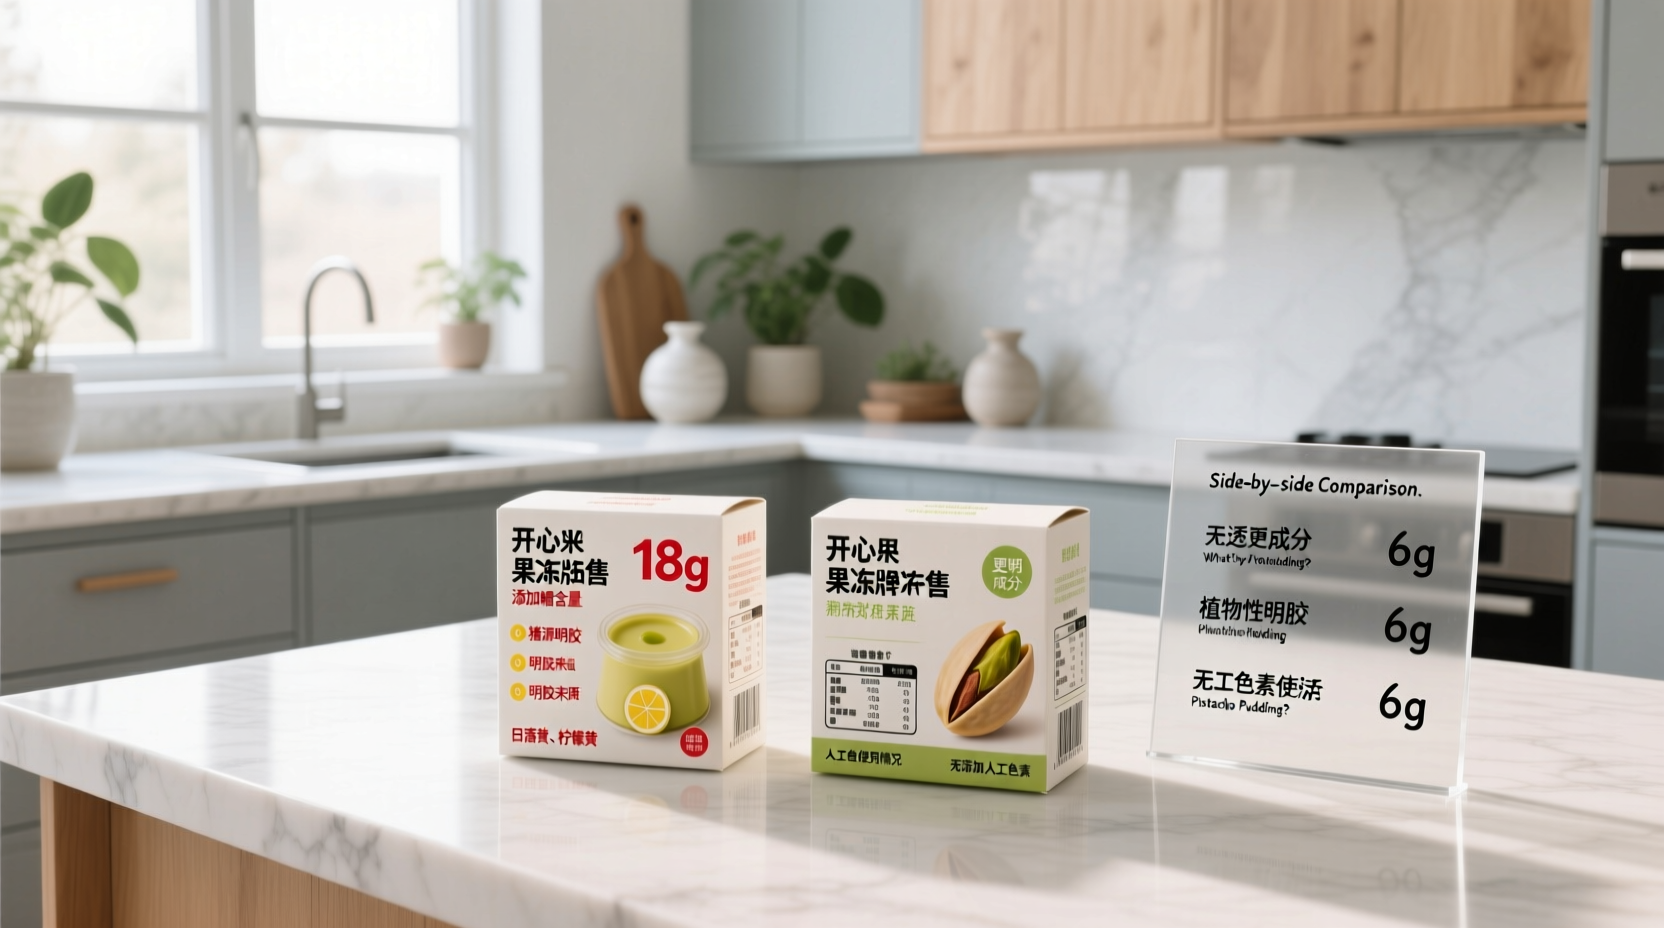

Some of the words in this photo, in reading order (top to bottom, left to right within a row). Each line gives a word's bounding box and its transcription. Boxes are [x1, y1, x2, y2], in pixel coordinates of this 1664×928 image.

[1209, 472, 1314, 496] Side-by-side
[1318, 477, 1422, 499] Comparison.
[826, 535, 899, 564] 开心果
[1205, 525, 1312, 551] 无透更成分
[1388, 530, 1436, 578] 6g
[633, 538, 709, 593] 18g
[1199, 596, 1309, 625] 植物性明胶
[1384, 606, 1432, 655] 6g
[1379, 682, 1426, 731] 6g
